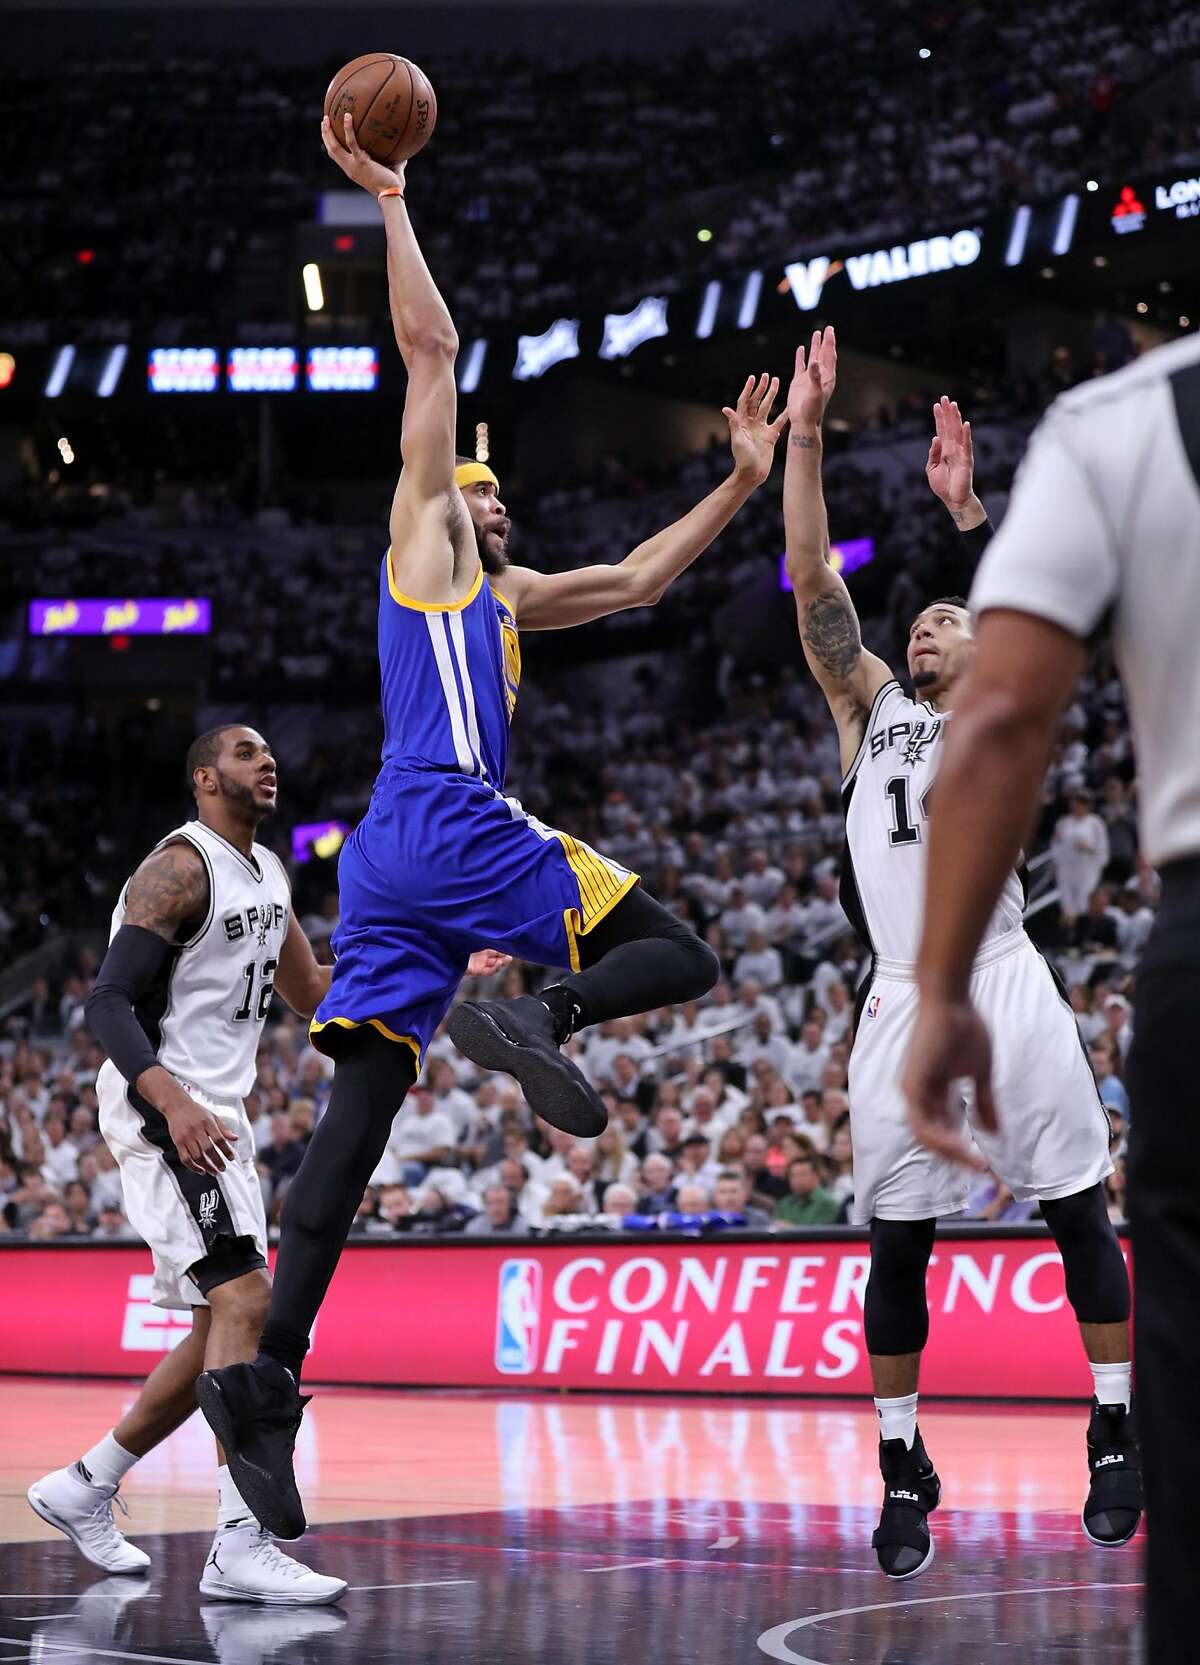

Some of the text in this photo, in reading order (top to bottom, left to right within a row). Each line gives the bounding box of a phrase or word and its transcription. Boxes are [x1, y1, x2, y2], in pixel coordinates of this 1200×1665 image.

[1155, 177, 1200, 210] LON
[845, 229, 982, 291] VALERO
[870, 720, 945, 768] SPU
[884, 776, 930, 848] 1
[223, 903, 288, 946] SPUR
[232, 957, 278, 1022] 12
[552, 1253, 1127, 1316] CONFERNC
[542, 1318, 862, 1379] FINALS
